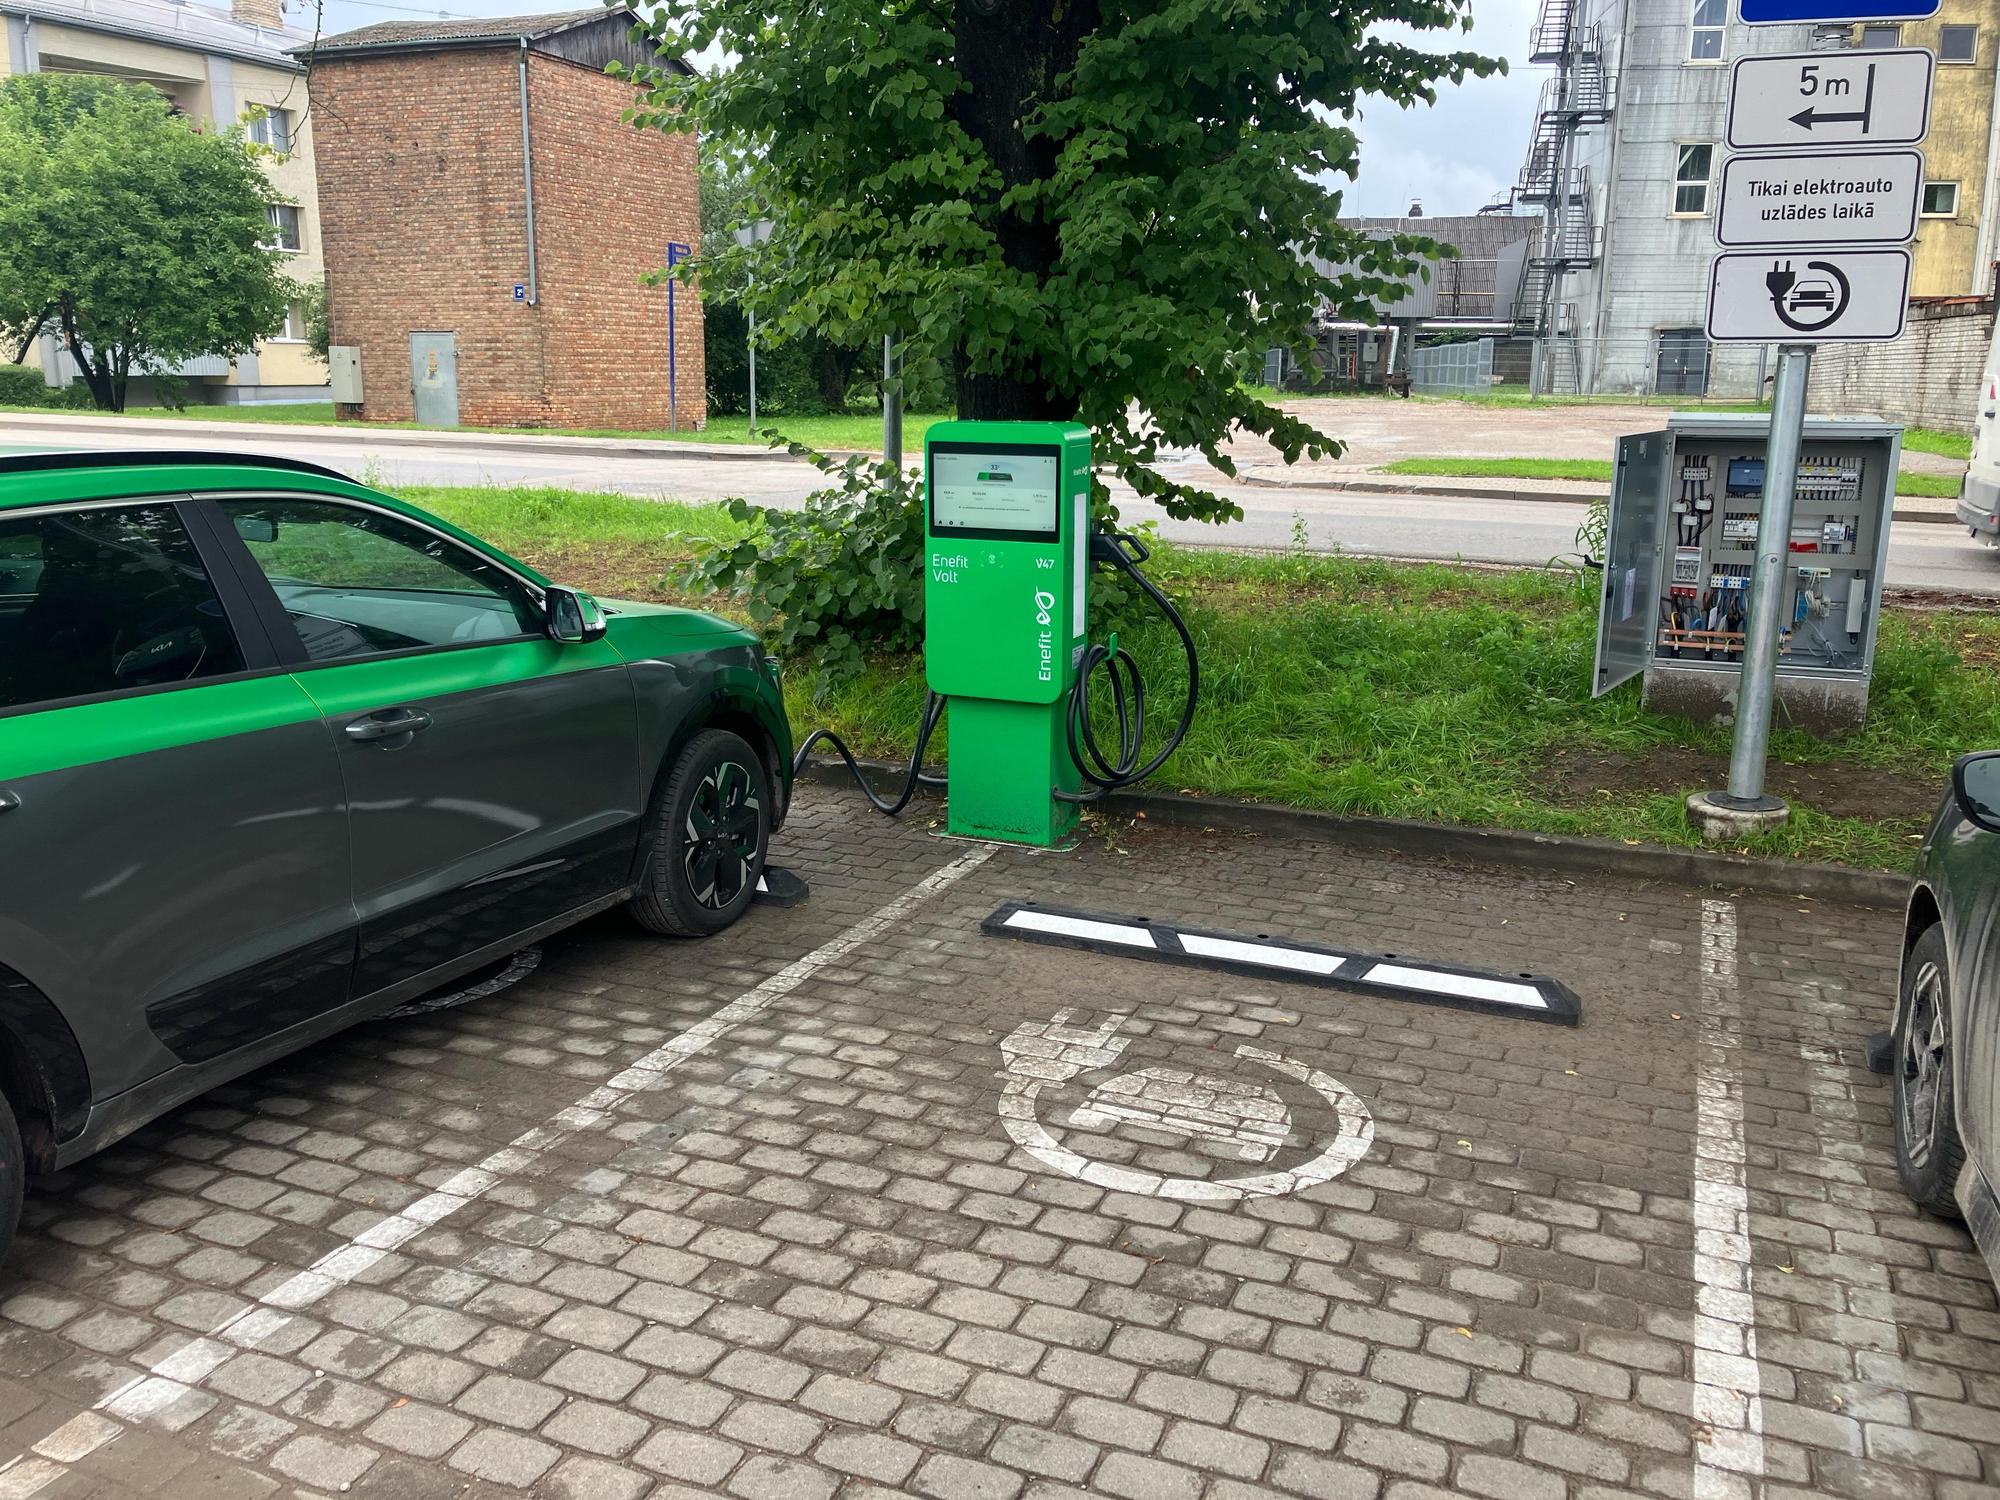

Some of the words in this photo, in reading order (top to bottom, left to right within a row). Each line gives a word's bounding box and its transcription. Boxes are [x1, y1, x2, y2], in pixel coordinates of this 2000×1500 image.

[1799, 65, 1820, 97] 5
[1824, 77, 1850, 96] m
[1748, 179, 1788, 197] Tikai
[1793, 178, 1893, 196] elektroauto
[1761, 203, 1827, 221] uzlādes
[1833, 202, 1875, 219] laikā
[932, 553, 969, 569] Enefit
[1035, 558, 1055, 569] V47
[932, 569, 959, 583] Volt
[1038, 630, 1052, 681] Enefit
